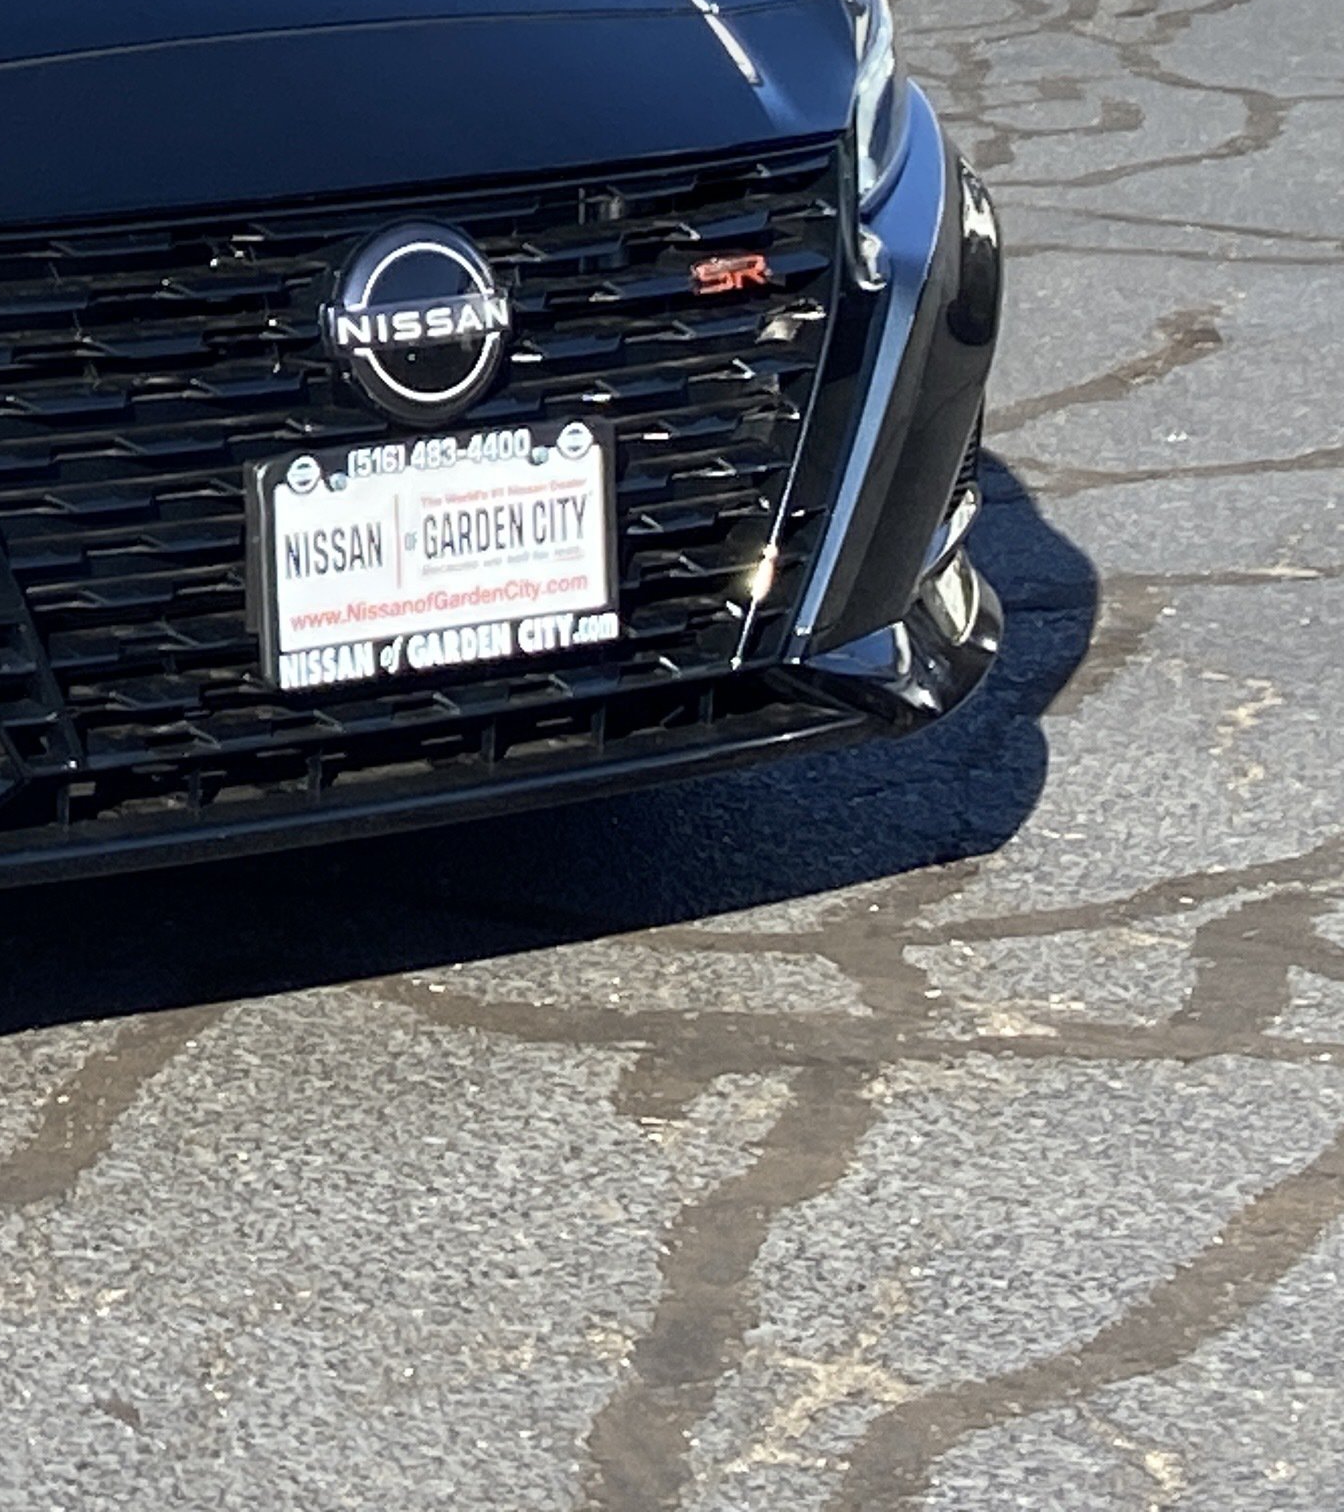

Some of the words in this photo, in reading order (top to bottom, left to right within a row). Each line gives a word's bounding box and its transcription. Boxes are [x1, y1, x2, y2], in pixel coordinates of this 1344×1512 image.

[691, 254, 768, 295] SR
[336, 298, 510, 345] NISSAN
[348, 444, 406, 477] (516)
[410, 428, 531, 471] 483-4400
[284, 521, 383, 580] NISSAN
[422, 501, 524, 560] GARDEN
[532, 493, 589, 544] CITY
[289, 574, 589, 631] www.NissanofGardenCity.com
[279, 641, 376, 690] NISSAN
[379, 635, 404, 674] of
[406, 621, 512, 669] GARDEN
